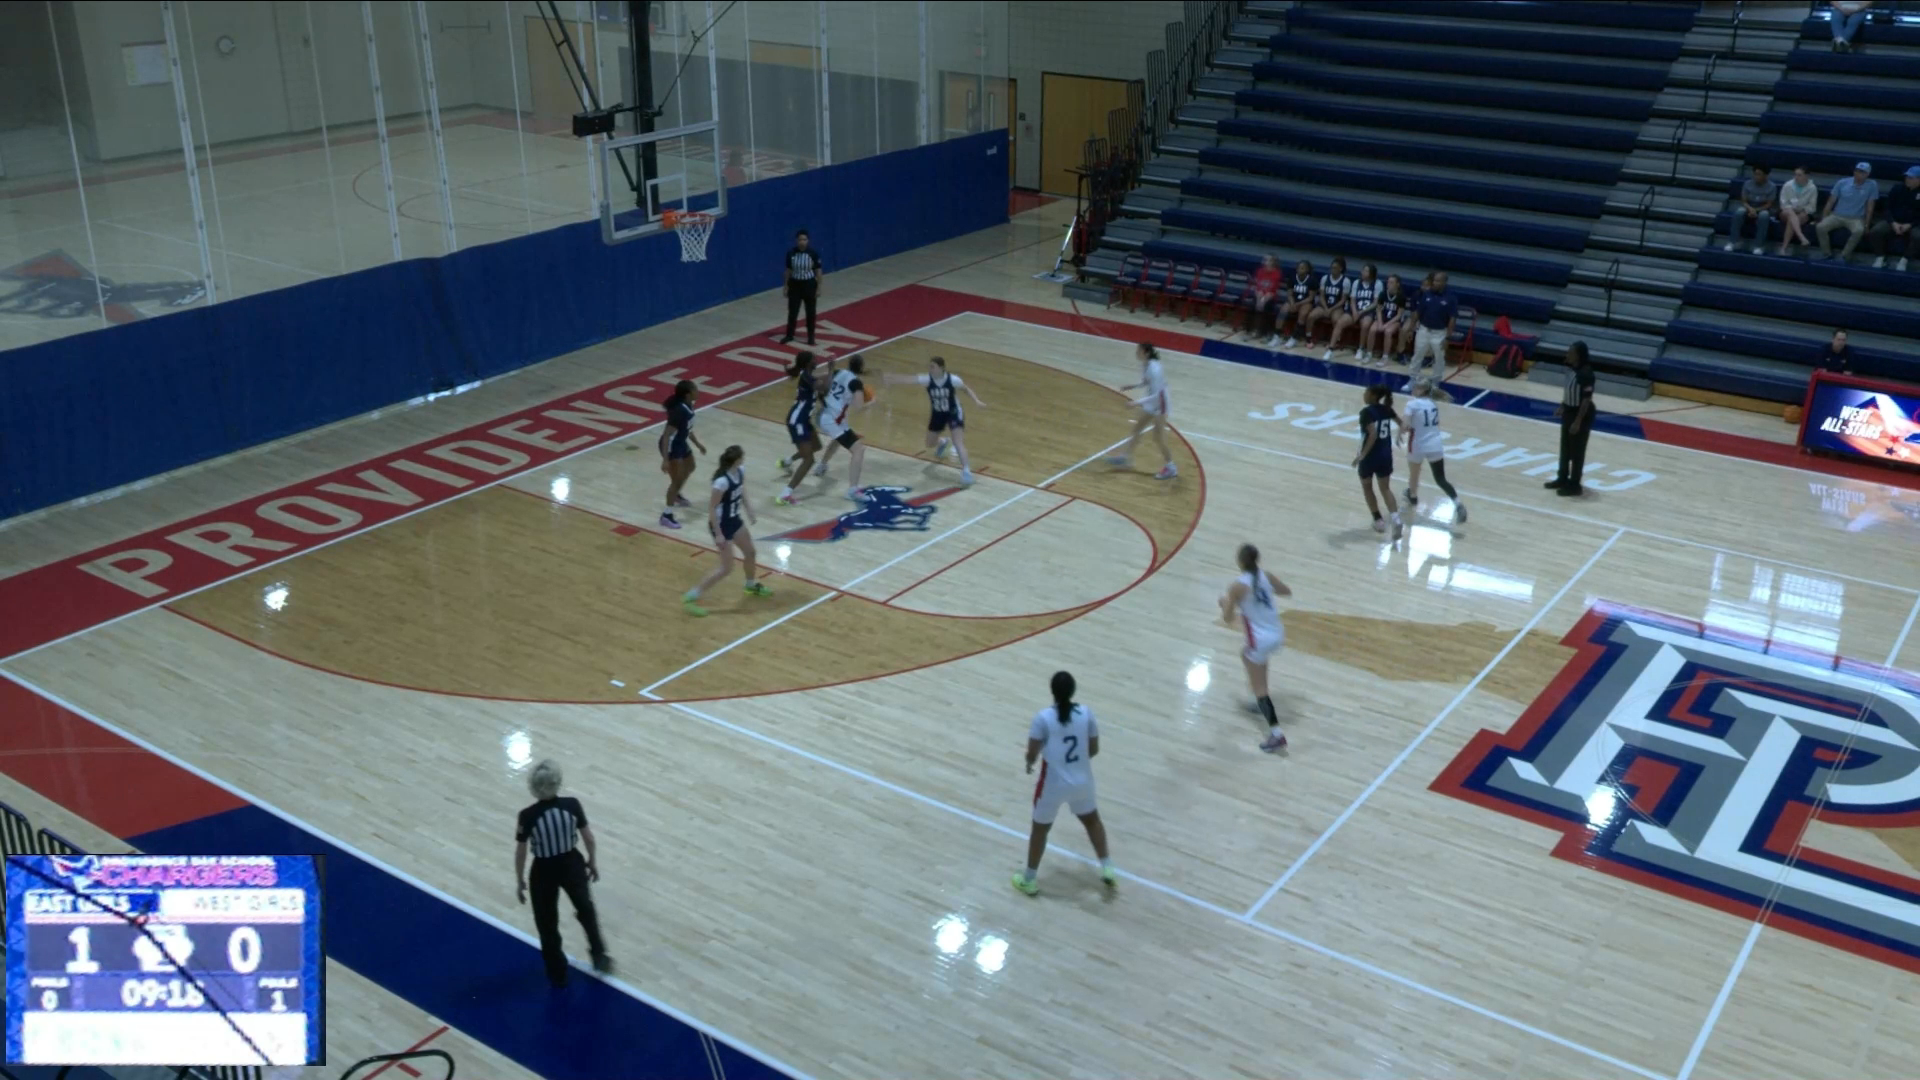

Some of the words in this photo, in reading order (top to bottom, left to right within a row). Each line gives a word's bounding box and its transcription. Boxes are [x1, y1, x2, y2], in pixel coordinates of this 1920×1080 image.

[1423, 408, 1439, 428] 12
[1840, 406, 1873, 423] WEST
[1820, 416, 1883, 440] ALL-STARS
[76, 367, 750, 599] PROVIDENCE
[716, 319, 881, 373] DAY
[1062, 735, 1079, 764] 2
